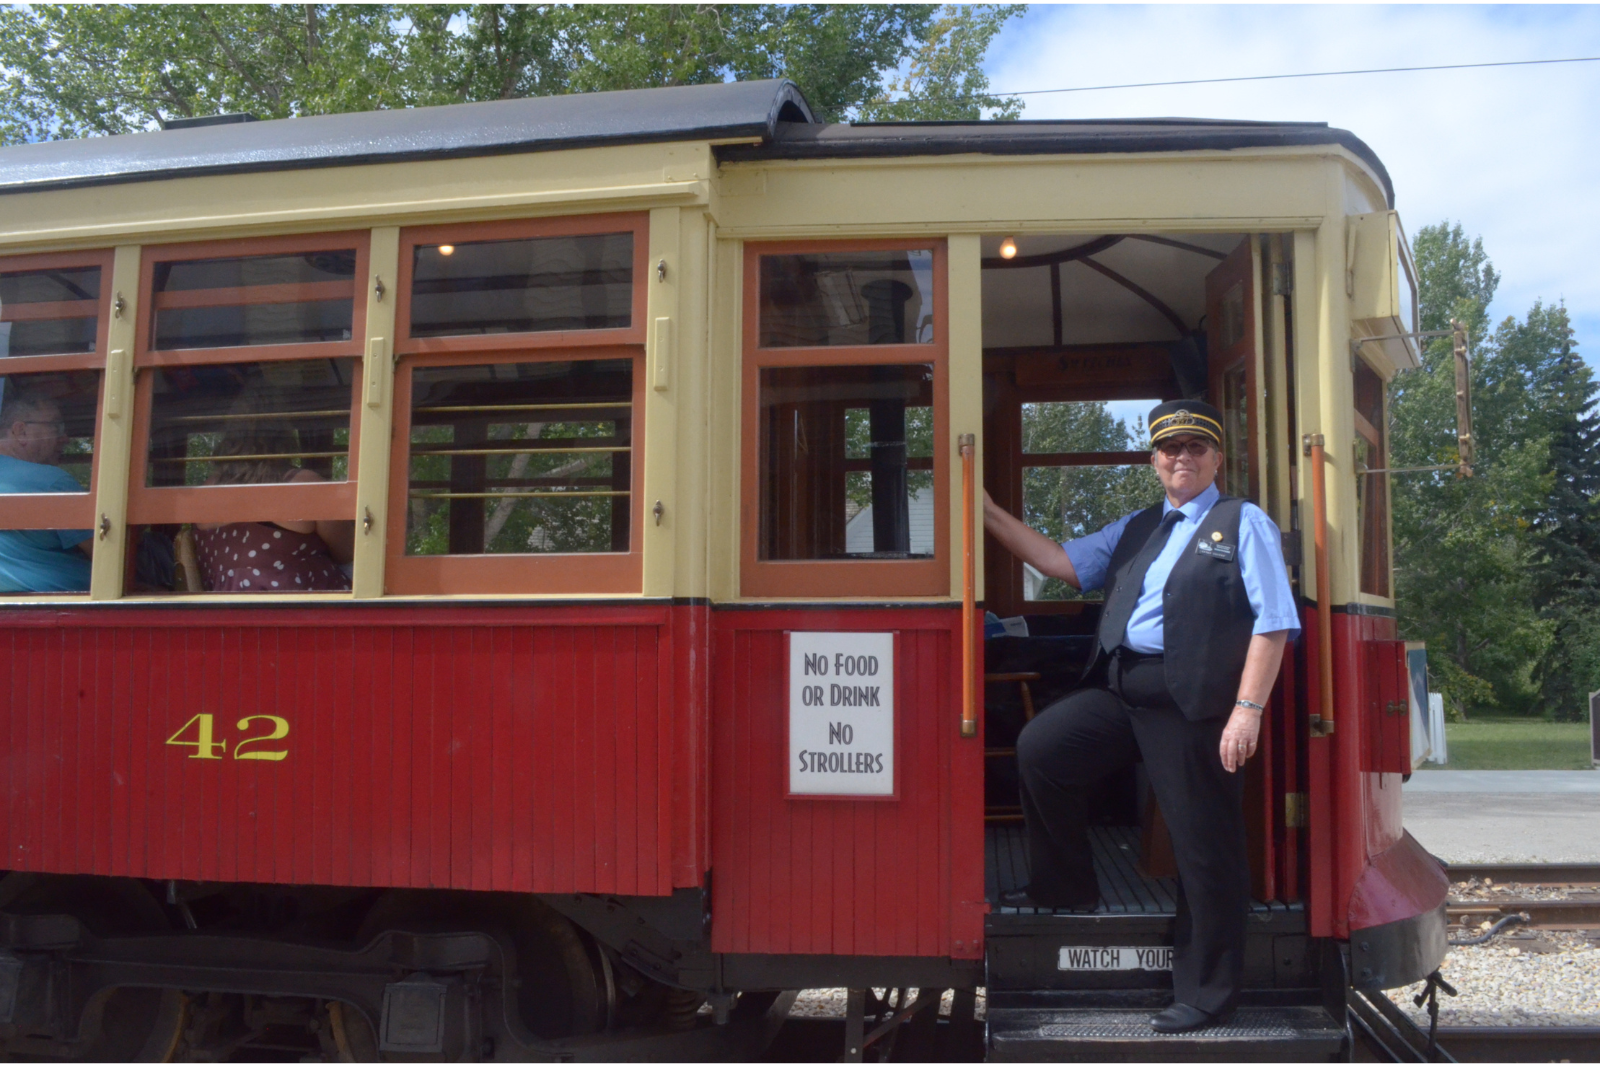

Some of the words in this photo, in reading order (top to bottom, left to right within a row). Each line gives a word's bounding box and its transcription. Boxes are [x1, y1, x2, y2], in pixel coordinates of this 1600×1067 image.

[804, 652, 828, 676] NO
[834, 653, 879, 676] FOOD
[802, 685, 824, 706] OR
[830, 683, 880, 707] DRINK
[165, 713, 290, 761] 42
[828, 721, 854, 745] NO
[798, 749, 884, 774] STROLLERS
[1068, 949, 1120, 968] WATCH
[1136, 949, 1173, 968] YOUR
